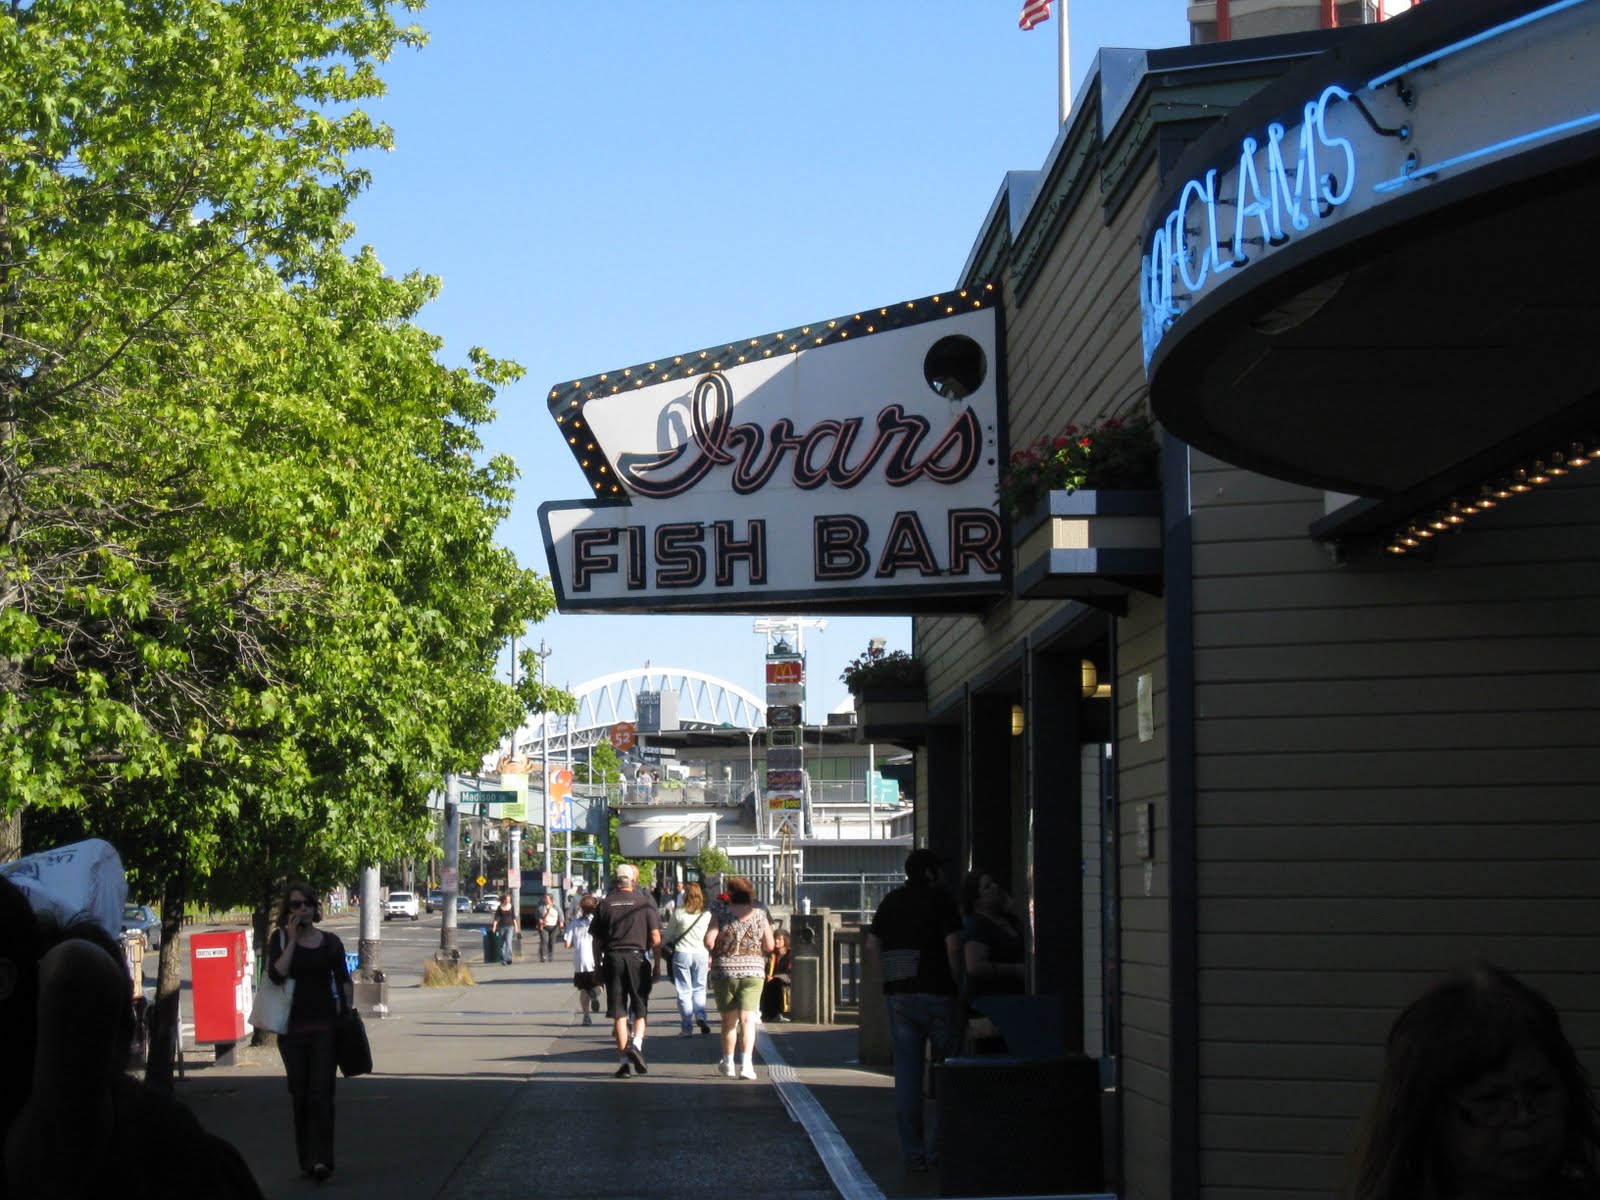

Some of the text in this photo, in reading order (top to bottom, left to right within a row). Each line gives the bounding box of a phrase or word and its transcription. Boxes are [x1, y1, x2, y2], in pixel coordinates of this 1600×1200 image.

[1176, 85, 1356, 293] CLAMS
[572, 507, 1001, 593] FISH BAR
[615, 732, 630, 747] 52
[462, 792, 497, 802] Madison
